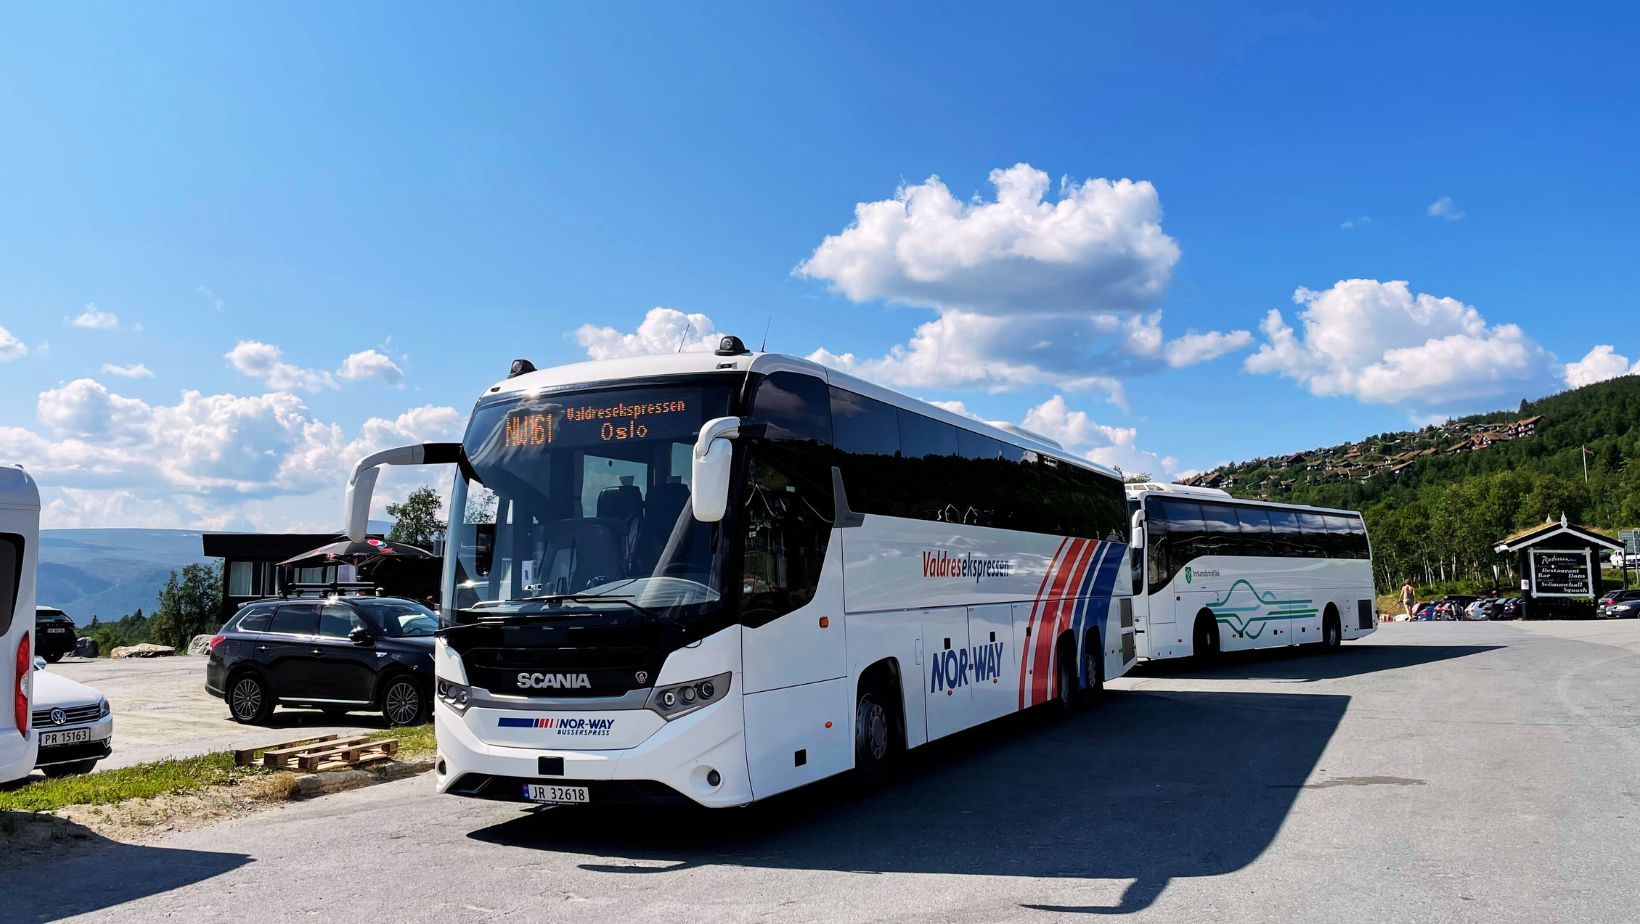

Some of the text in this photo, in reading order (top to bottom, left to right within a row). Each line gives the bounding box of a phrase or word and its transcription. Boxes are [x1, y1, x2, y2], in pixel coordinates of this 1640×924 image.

[566, 400, 686, 422] Valdresekspressen
[505, 414, 552, 447] NW161
[601, 421, 648, 441] Oslo
[923, 550, 1009, 583] Valdresekspressen
[931, 642, 1004, 694] NOR-WAY
[516, 672, 592, 689] SCANIA
[558, 719, 616, 730] NOR-WAY
[45, 730, 87, 745] PR 15163
[534, 786, 546, 799] JR
[550, 787, 585, 801] 32618
